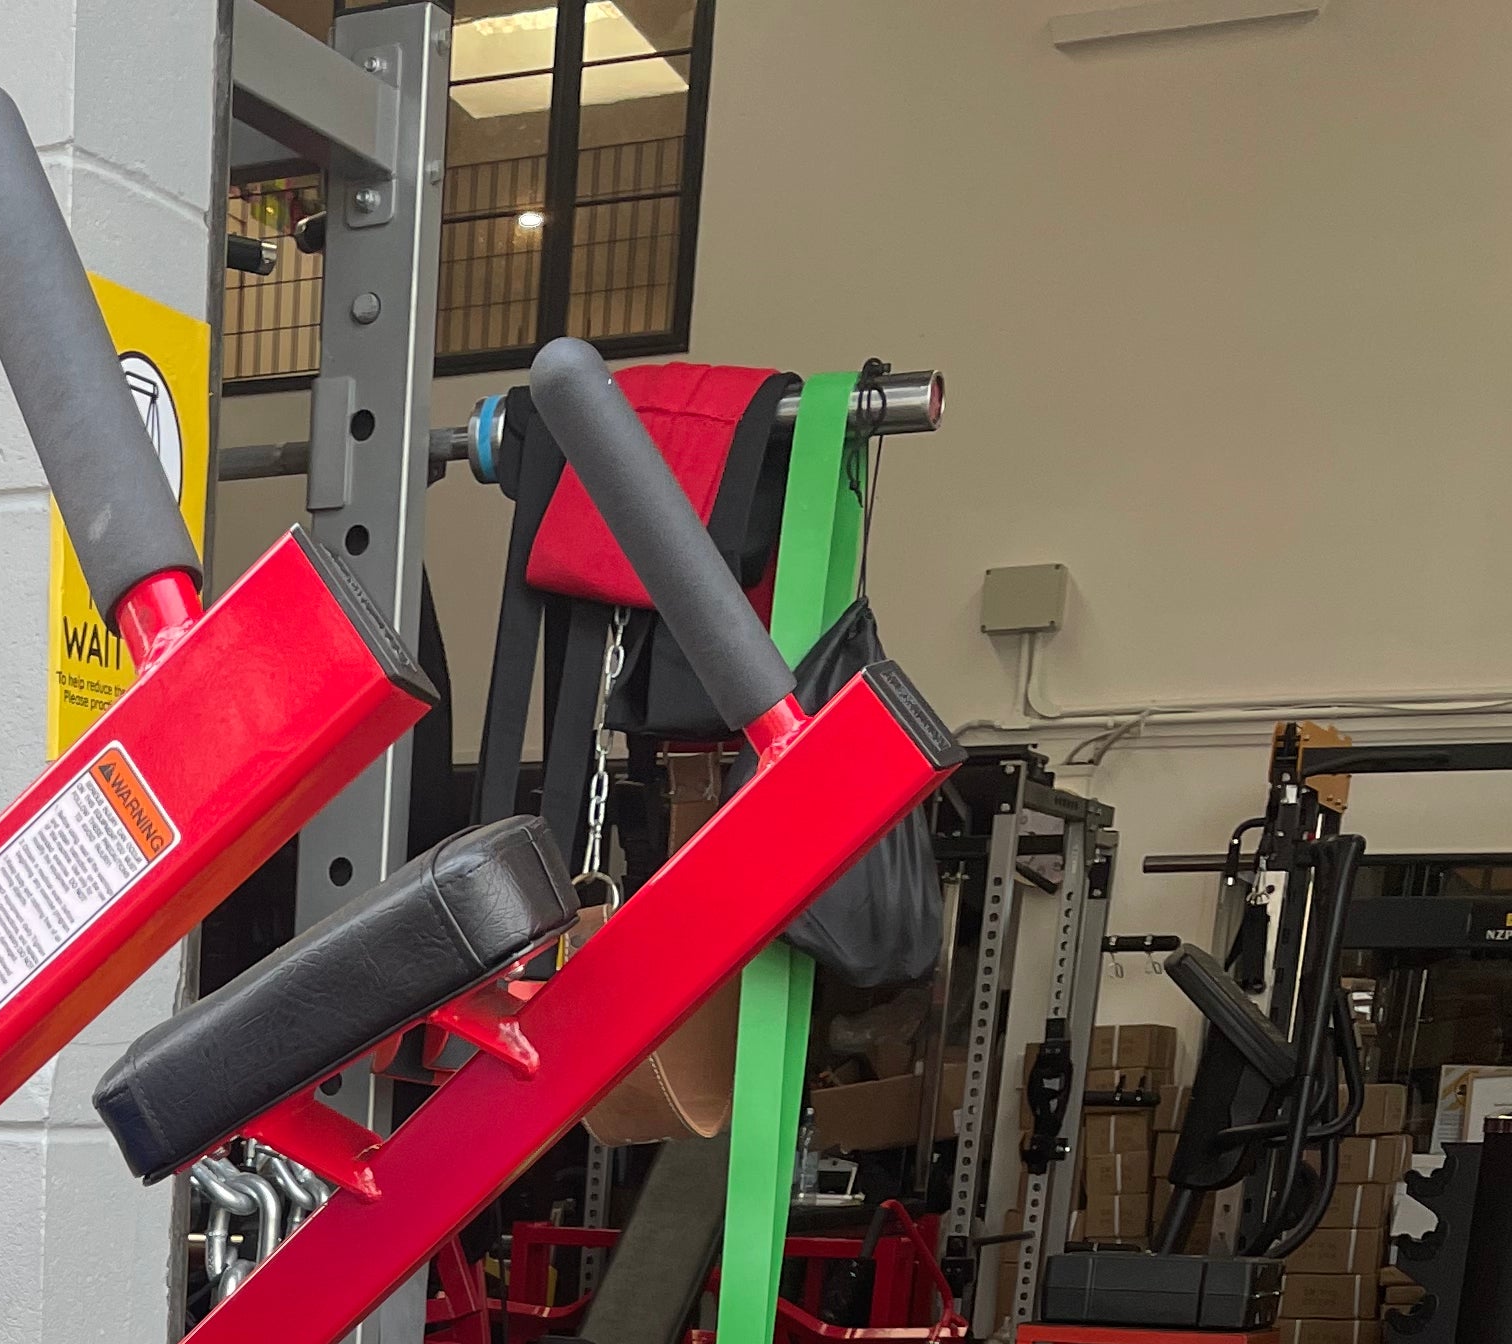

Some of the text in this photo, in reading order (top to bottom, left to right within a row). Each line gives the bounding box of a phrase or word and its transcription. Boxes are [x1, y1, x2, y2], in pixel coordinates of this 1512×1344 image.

[56, 671, 67, 685] To
[68, 673, 84, 690] help
[86, 680, 113, 695] reduce
[64, 689, 89, 707] Please
[110, 773, 165, 853] WARNING
